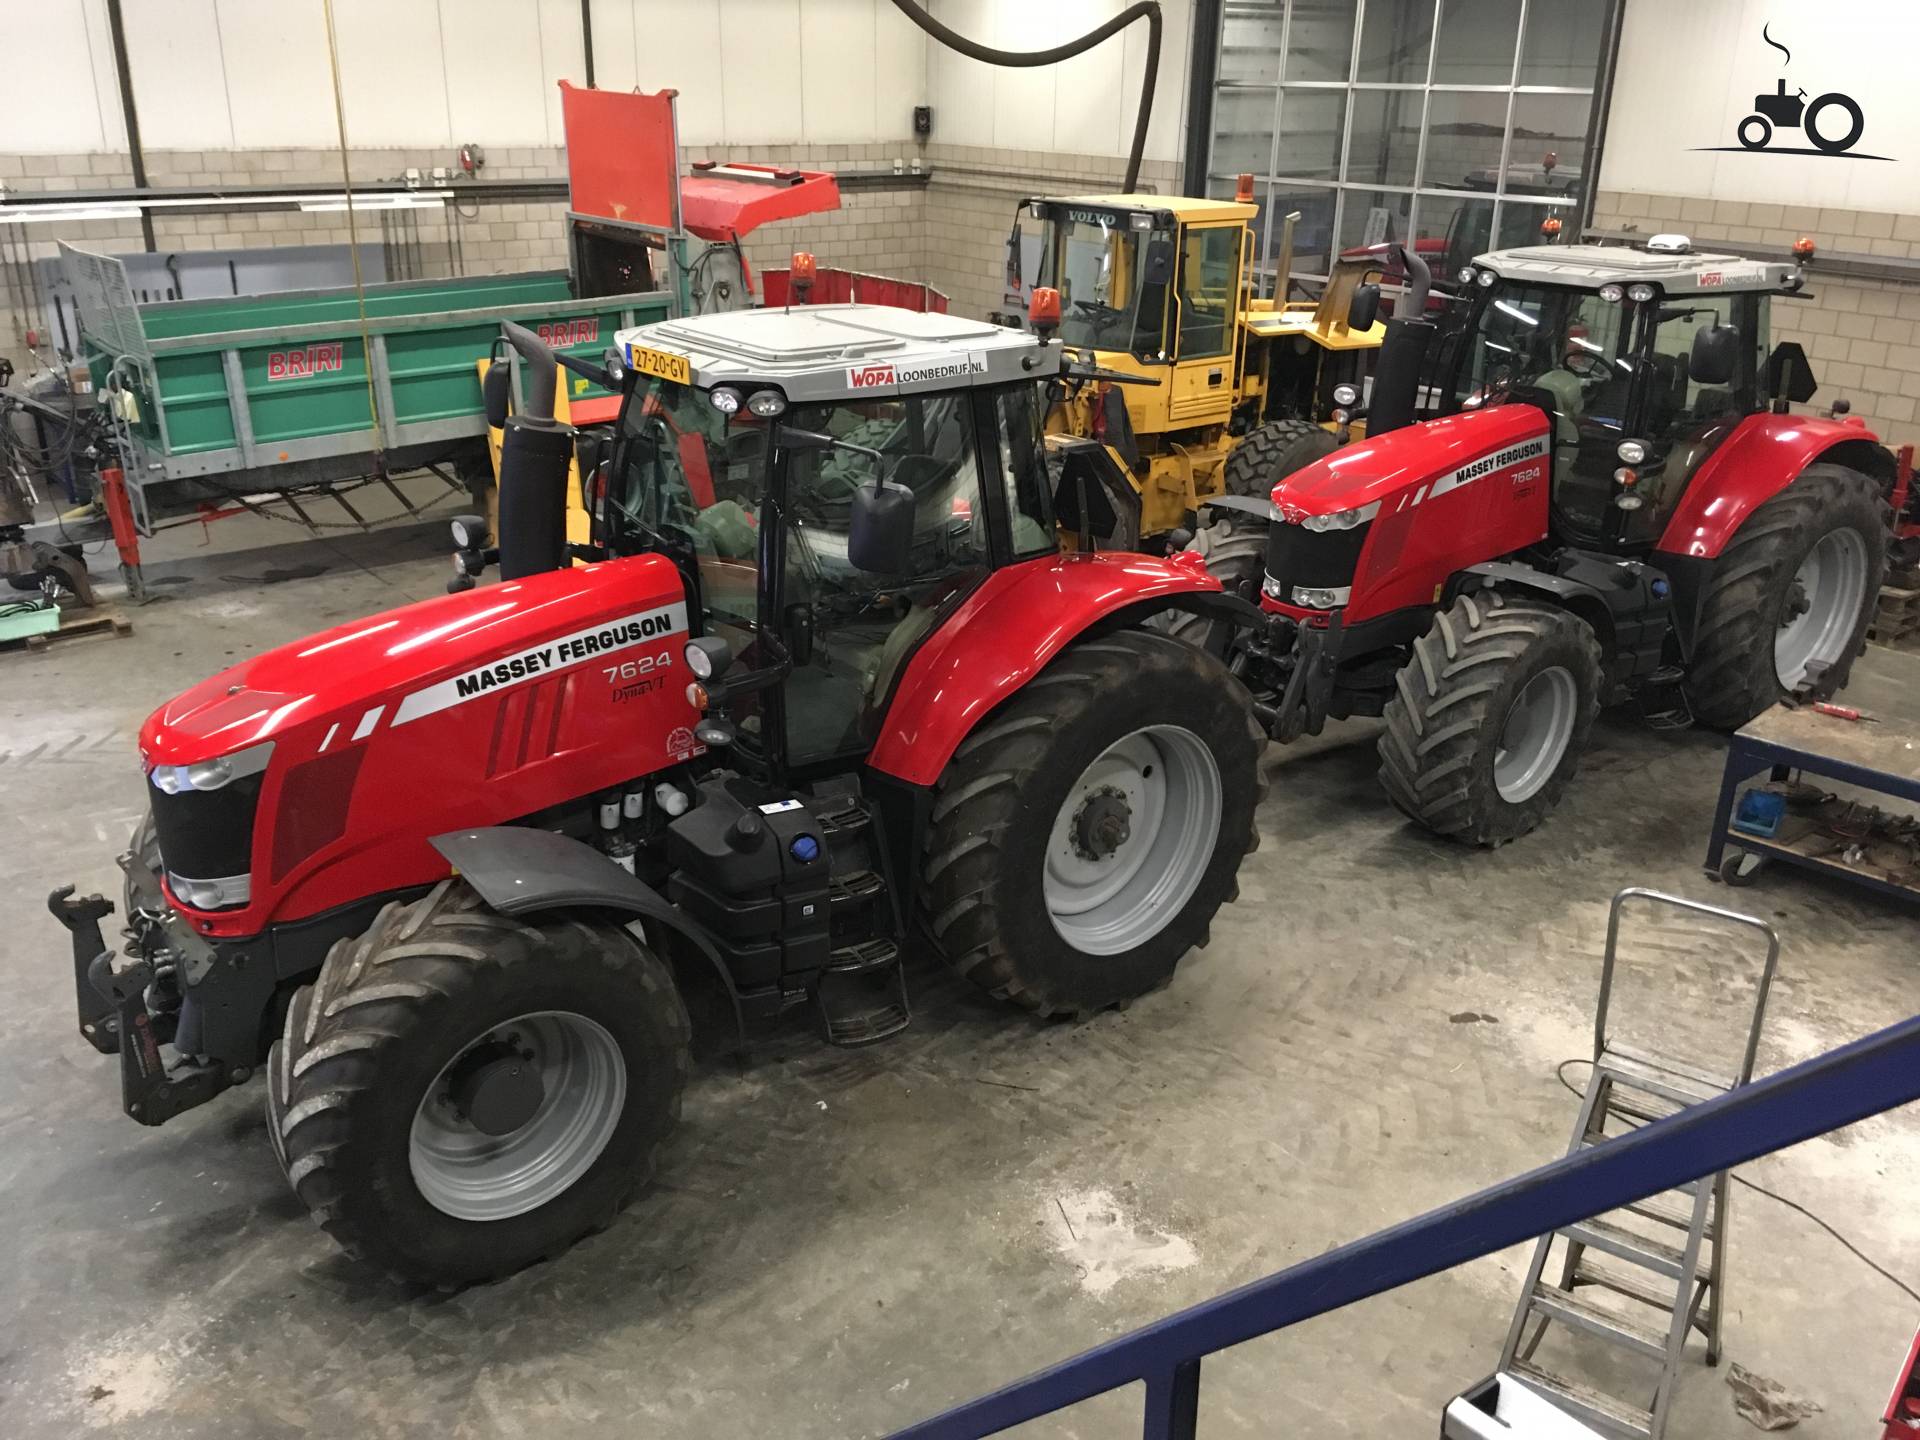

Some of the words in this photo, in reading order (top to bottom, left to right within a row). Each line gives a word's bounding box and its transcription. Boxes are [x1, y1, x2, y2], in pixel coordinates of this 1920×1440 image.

[1069, 210, 1116, 225] VOLVO
[538, 318, 598, 350] BRIRI
[268, 343, 343, 381] BRIRI
[635, 349, 684, 379] 27-20-GV
[851, 365, 894, 387] WOPA
[898, 361, 984, 383] LOONBEDRIJF.NL
[1456, 457, 1495, 484] MASSEY
[1496, 441, 1543, 467] FERGUSON
[1511, 466, 1540, 485] 7624
[456, 648, 553, 697] MASSEY
[557, 613, 672, 663] FERGUSON
[602, 651, 672, 683] 7624
